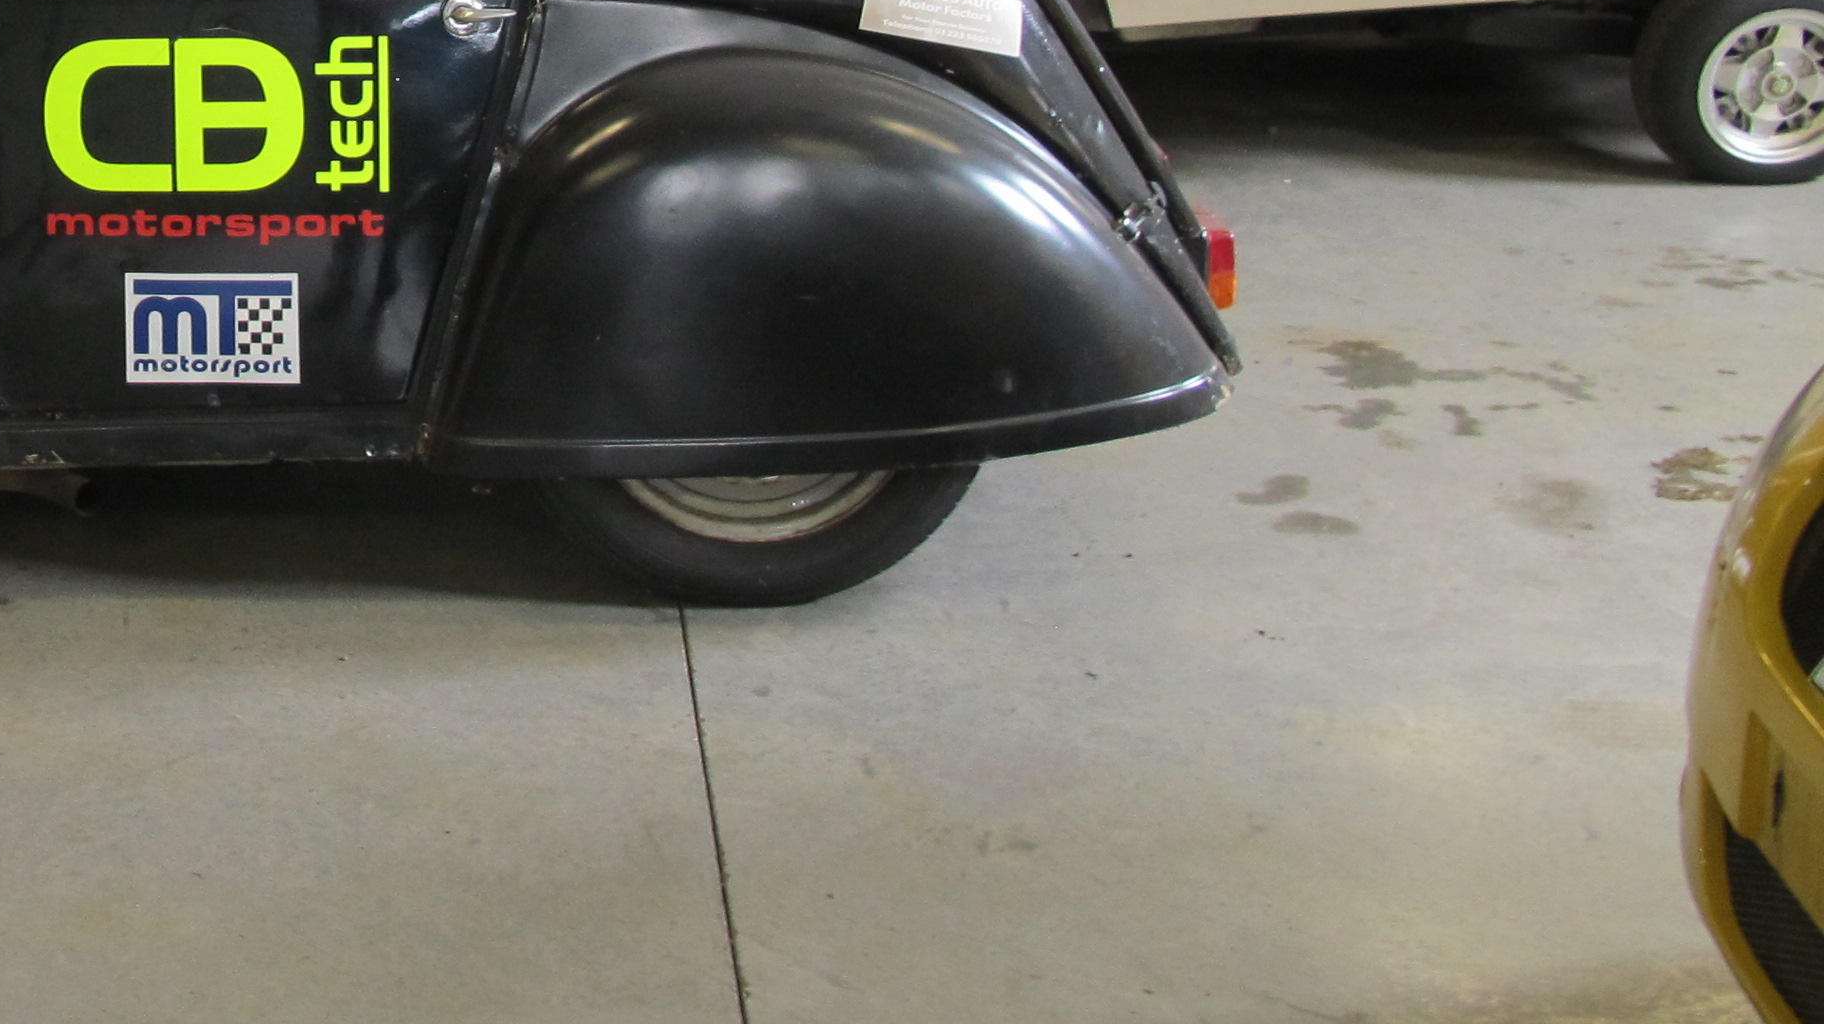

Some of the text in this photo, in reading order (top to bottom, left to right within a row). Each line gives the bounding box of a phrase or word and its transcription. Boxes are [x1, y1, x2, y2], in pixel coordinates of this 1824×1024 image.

[944, 5, 993, 23] Factors
[43, 37, 305, 193] CB
[314, 35, 374, 192] tech
[46, 209, 385, 245] motorsport
[133, 355, 292, 377] motorsport
